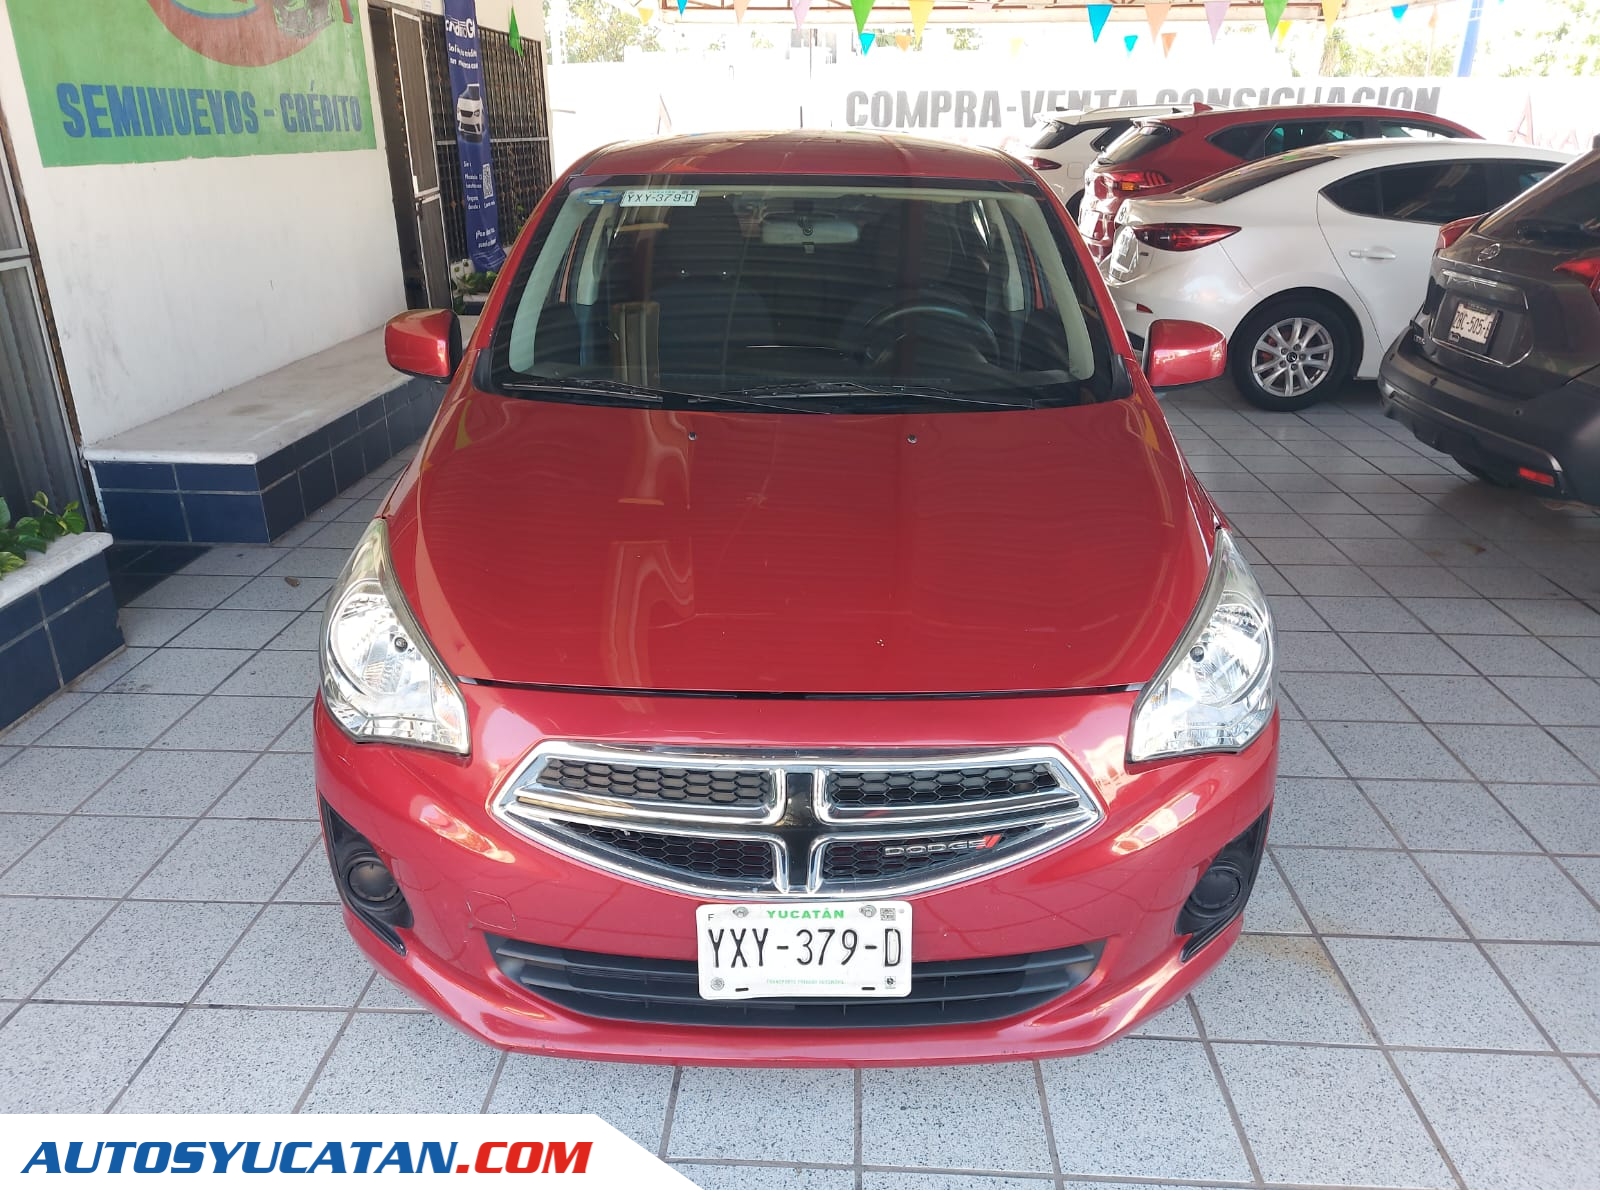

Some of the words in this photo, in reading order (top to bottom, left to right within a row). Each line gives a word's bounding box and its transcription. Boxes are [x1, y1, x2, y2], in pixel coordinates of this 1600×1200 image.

[56, 82, 260, 138] SEMINUEVOS
[279, 80, 363, 133] CRÉDITO
[626, 193, 694, 203] YXY-379-D
[884, 840, 987, 856] DODGE
[766, 907, 845, 919] YUCATÁN
[708, 928, 902, 968] YXY-379-D
